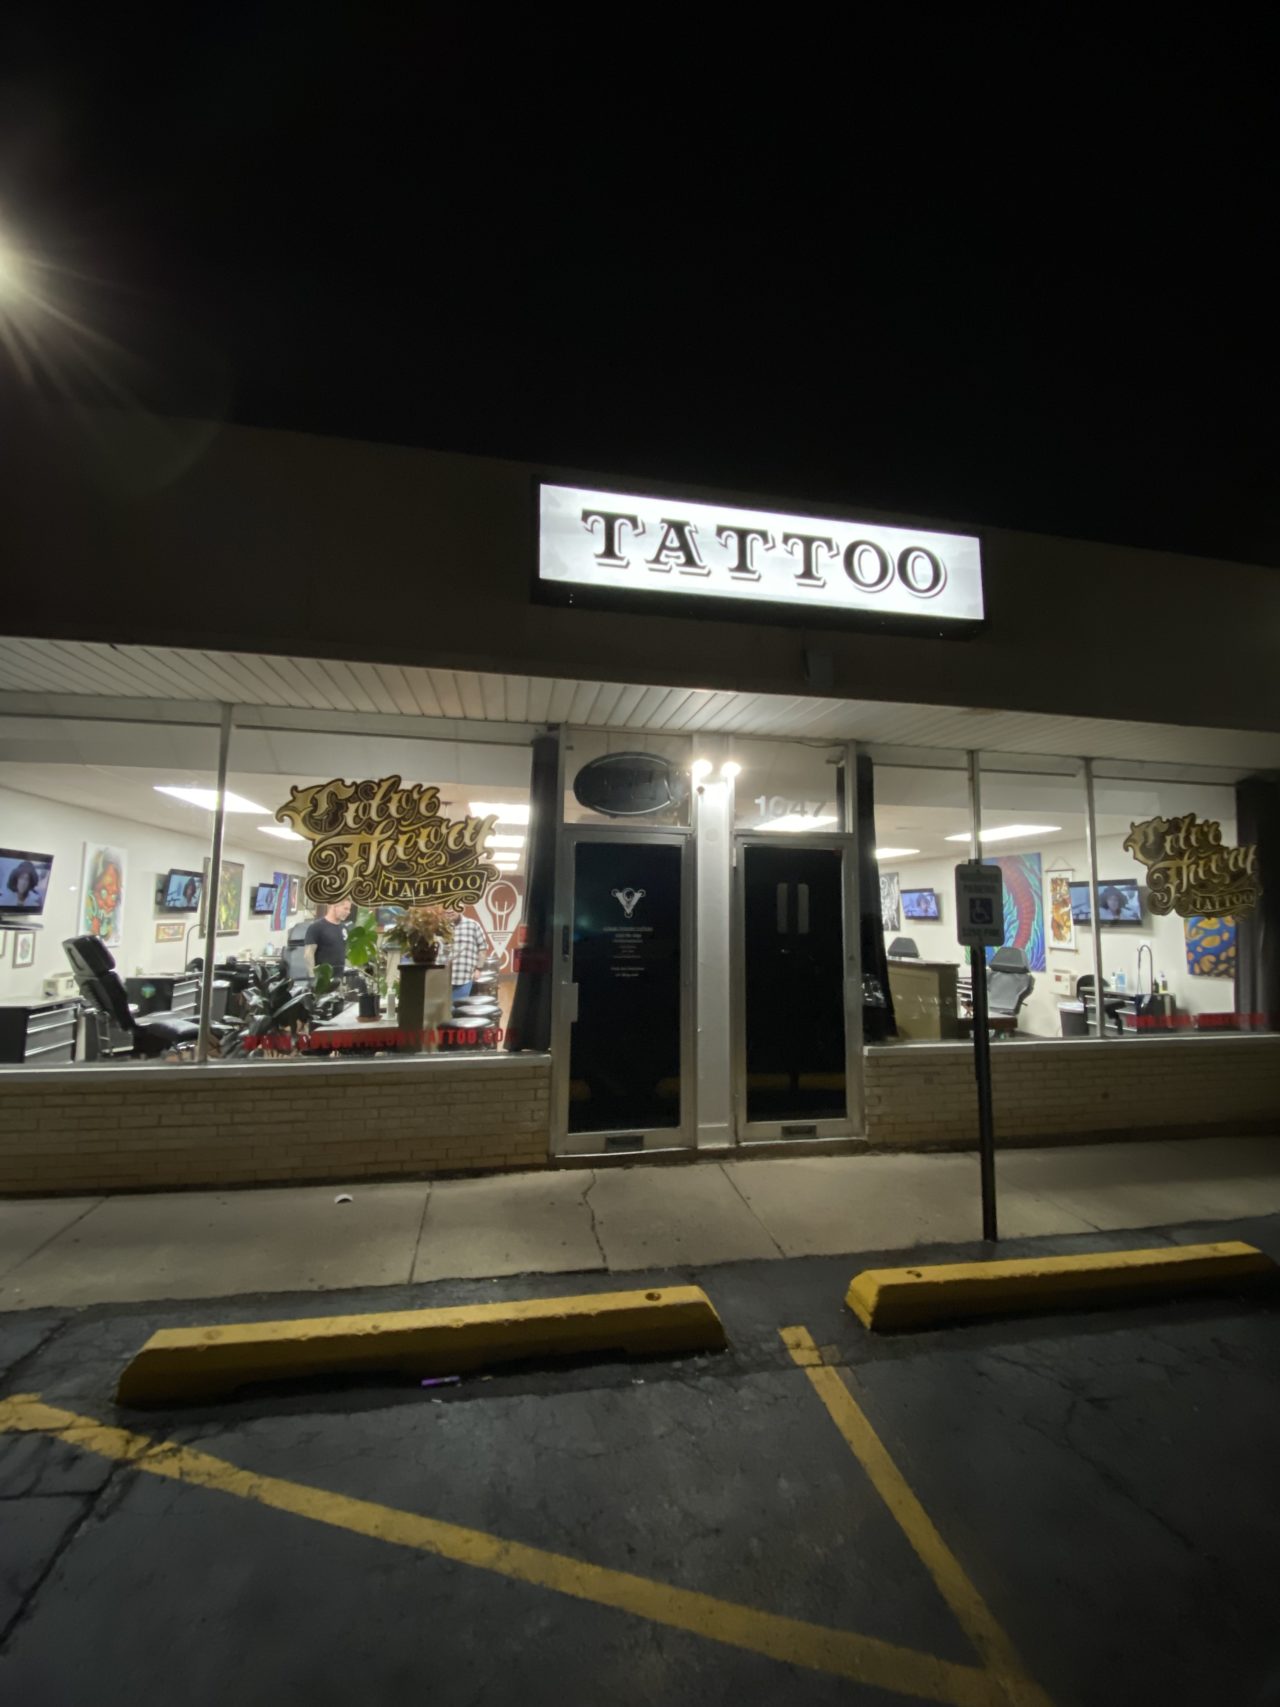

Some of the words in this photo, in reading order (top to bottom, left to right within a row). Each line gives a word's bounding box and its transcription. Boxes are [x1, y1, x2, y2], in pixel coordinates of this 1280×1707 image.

[580, 508, 948, 598] TATTOO
[276, 775, 441, 842] Color
[309, 815, 499, 890] Theory
[383, 874, 482, 898] TATTOO
[1194, 892, 1256, 911] TATTOO
